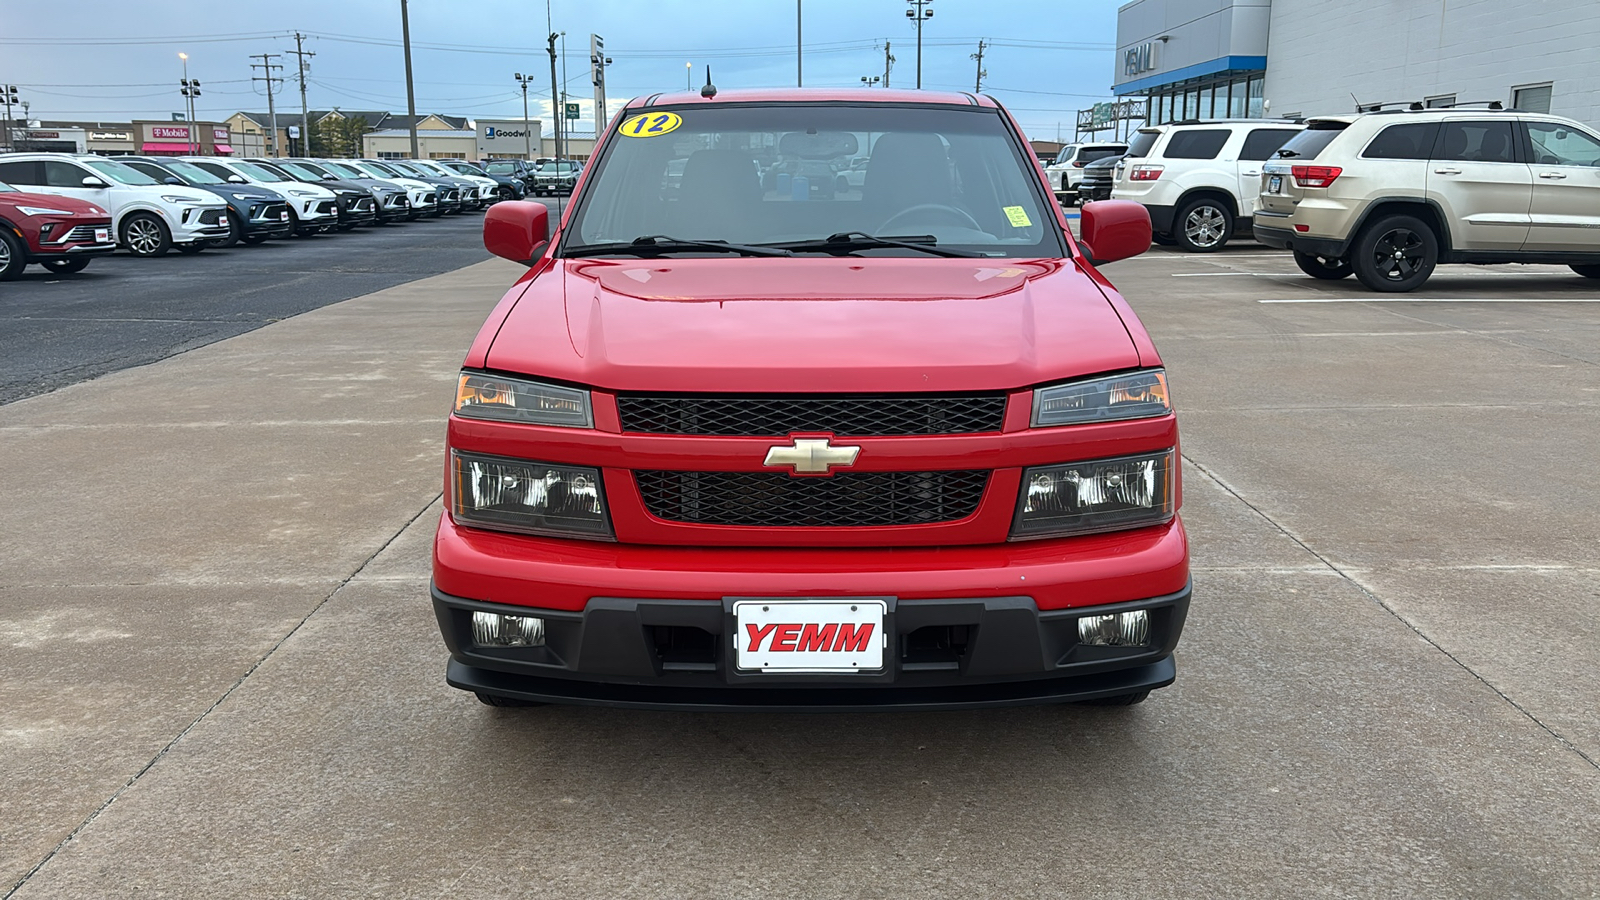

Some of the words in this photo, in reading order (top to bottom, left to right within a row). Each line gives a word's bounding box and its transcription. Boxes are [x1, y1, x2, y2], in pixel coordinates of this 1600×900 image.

[633, 115, 669, 133] 12
[162, 129, 188, 137] Mobile
[495, 129, 531, 138] Goodwil
[745, 623, 876, 652] YEMM
